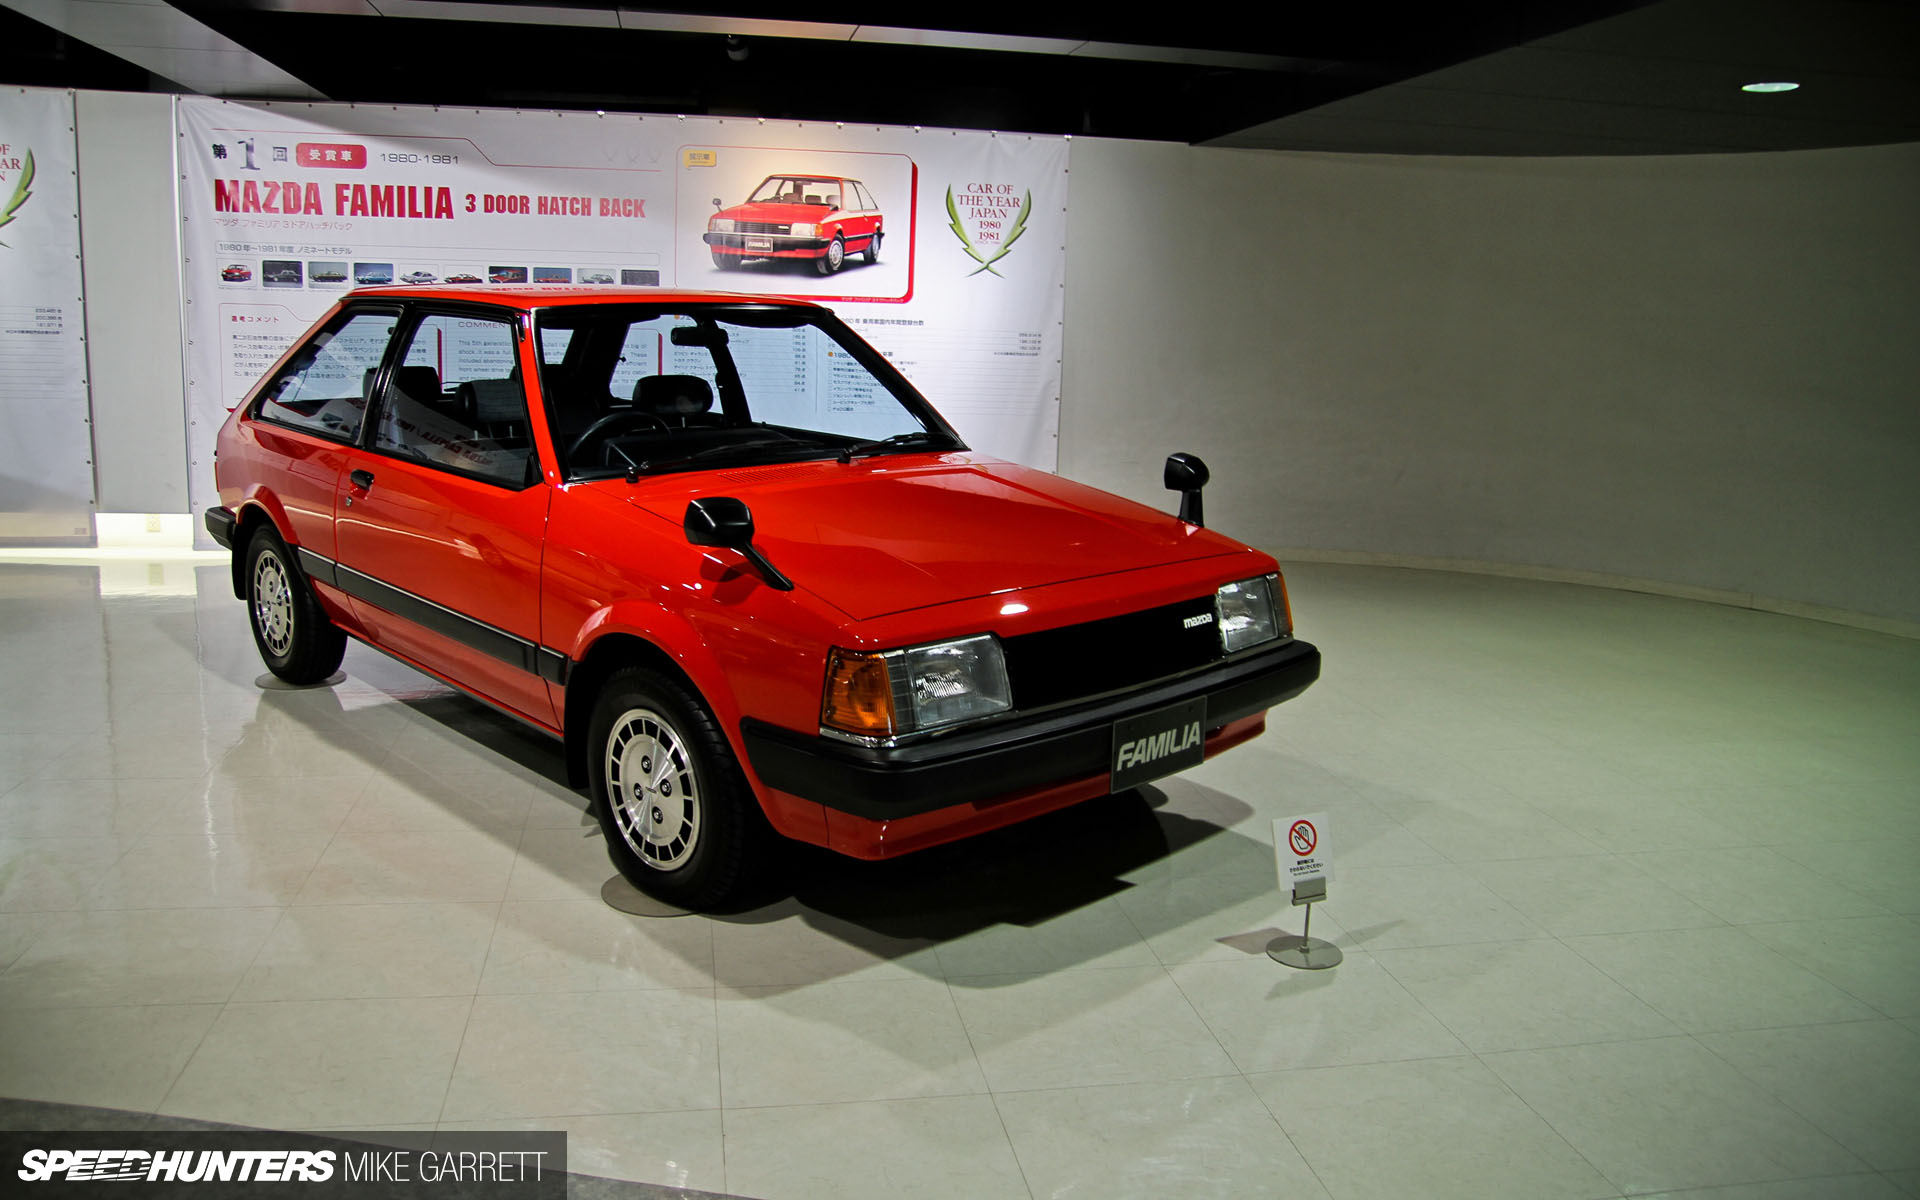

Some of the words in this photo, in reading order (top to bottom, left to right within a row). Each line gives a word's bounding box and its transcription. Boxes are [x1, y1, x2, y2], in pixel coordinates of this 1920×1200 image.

[309, 148, 353, 162] 受賞車
[380, 153, 459, 165] 1980-1981
[967, 183, 993, 194] CAR
[996, 184, 1014, 195] OF
[214, 179, 323, 216] MAZDA
[335, 183, 454, 220] FAMILIA
[465, 193, 476, 213] 3
[483, 194, 530, 215] DOOR
[537, 196, 592, 217] HATCH
[599, 197, 646, 219] BACK
[957, 194, 983, 206] THE
[986, 195, 1020, 208] YEAR
[968, 207, 1008, 220] JAPAN
[979, 220, 1001, 230] 1980
[979, 231, 1000, 241] 1981
[458, 321, 510, 329] COMMEN
[1183, 612, 1213, 629] mazda
[1116, 720, 1200, 772] FAMILIA
